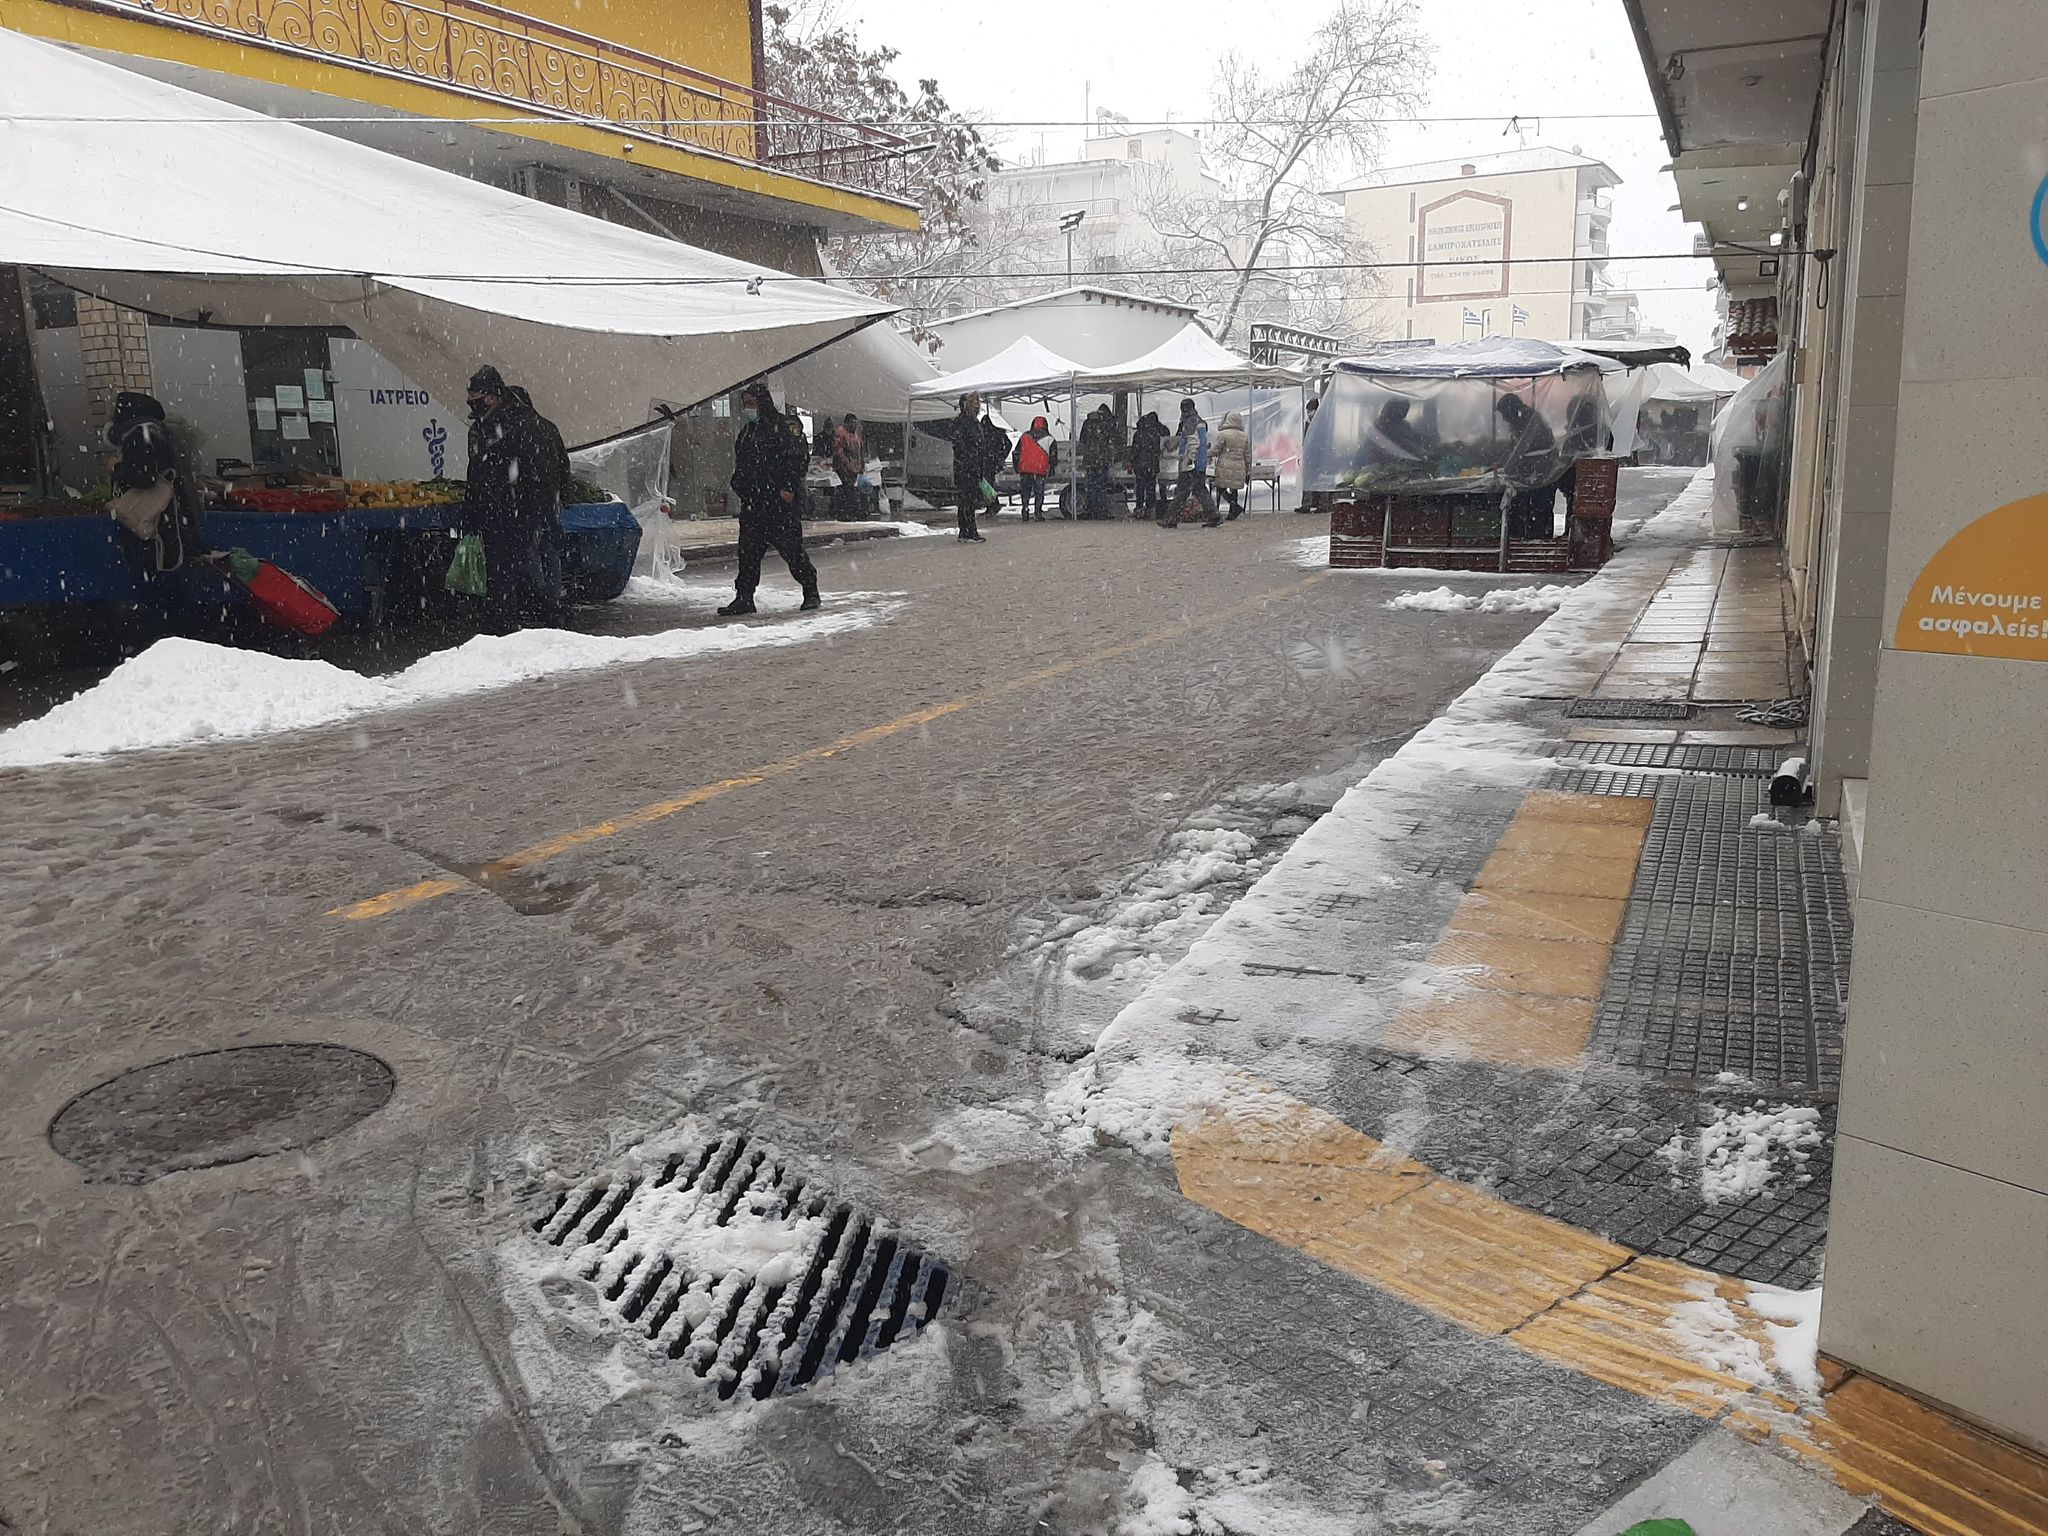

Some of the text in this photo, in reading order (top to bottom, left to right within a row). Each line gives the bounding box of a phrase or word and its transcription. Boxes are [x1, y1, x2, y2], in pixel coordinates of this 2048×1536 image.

[370, 389, 430, 405] ΙΑΤΡΕΙΟ
[1930, 585, 2042, 614] Μένουμε
[1918, 614, 2048, 640] ασφαλείς!
